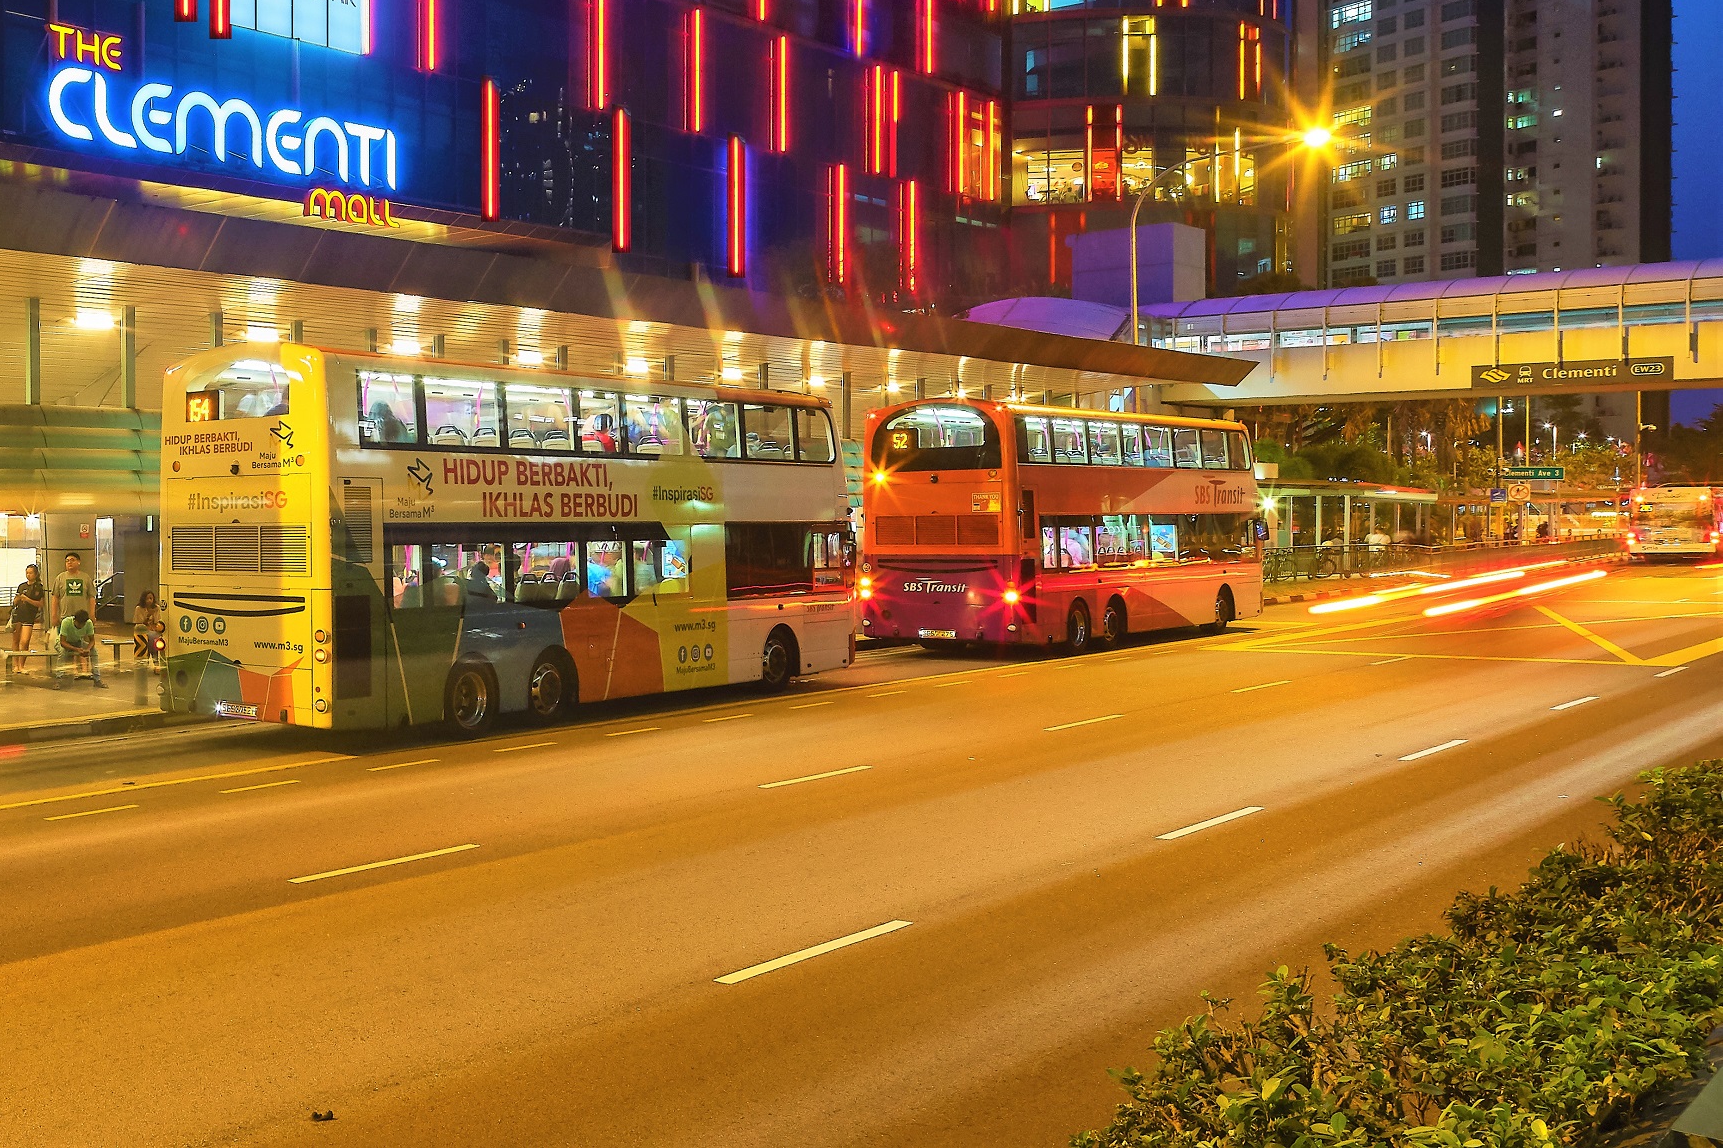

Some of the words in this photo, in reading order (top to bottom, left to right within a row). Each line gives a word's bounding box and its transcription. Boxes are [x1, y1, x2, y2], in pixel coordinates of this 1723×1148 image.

[49, 23, 122, 70] THE
[48, 68, 397, 191] CLEMENTI
[306, 187, 400, 229] MALL
[1542, 365, 1618, 380] Clementi
[1634, 365, 1662, 373] EW23
[189, 398, 210, 422] 154
[164, 434, 192, 446] HIDUP
[194, 431, 240, 444] BERBAKTI,
[893, 433, 908, 449] 52
[180, 444, 210, 456] IKHLAS
[214, 442, 252, 454] BERBUDI
[252, 460, 282, 469] Bersama
[442, 458, 509, 486] HIDUP
[516, 462, 613, 492] BERBAKTI,
[652, 485, 714, 504] #InspirasiSG
[1195, 485, 1210, 504] SBS
[1209, 480, 1245, 507] Transit
[188, 490, 288, 513] #InspirasiSG
[397, 497, 416, 508] Maju
[482, 492, 554, 518] IKHLAS
[560, 494, 638, 518] BERBUDI
[390, 509, 421, 518] Bersama
[904, 582, 923, 592] SBS
[921, 580, 969, 593] Transit
[674, 619, 716, 632] www.m3.sg
[178, 636, 228, 647] MajuBersamaM3
[254, 641, 304, 654] www.m3.sg
